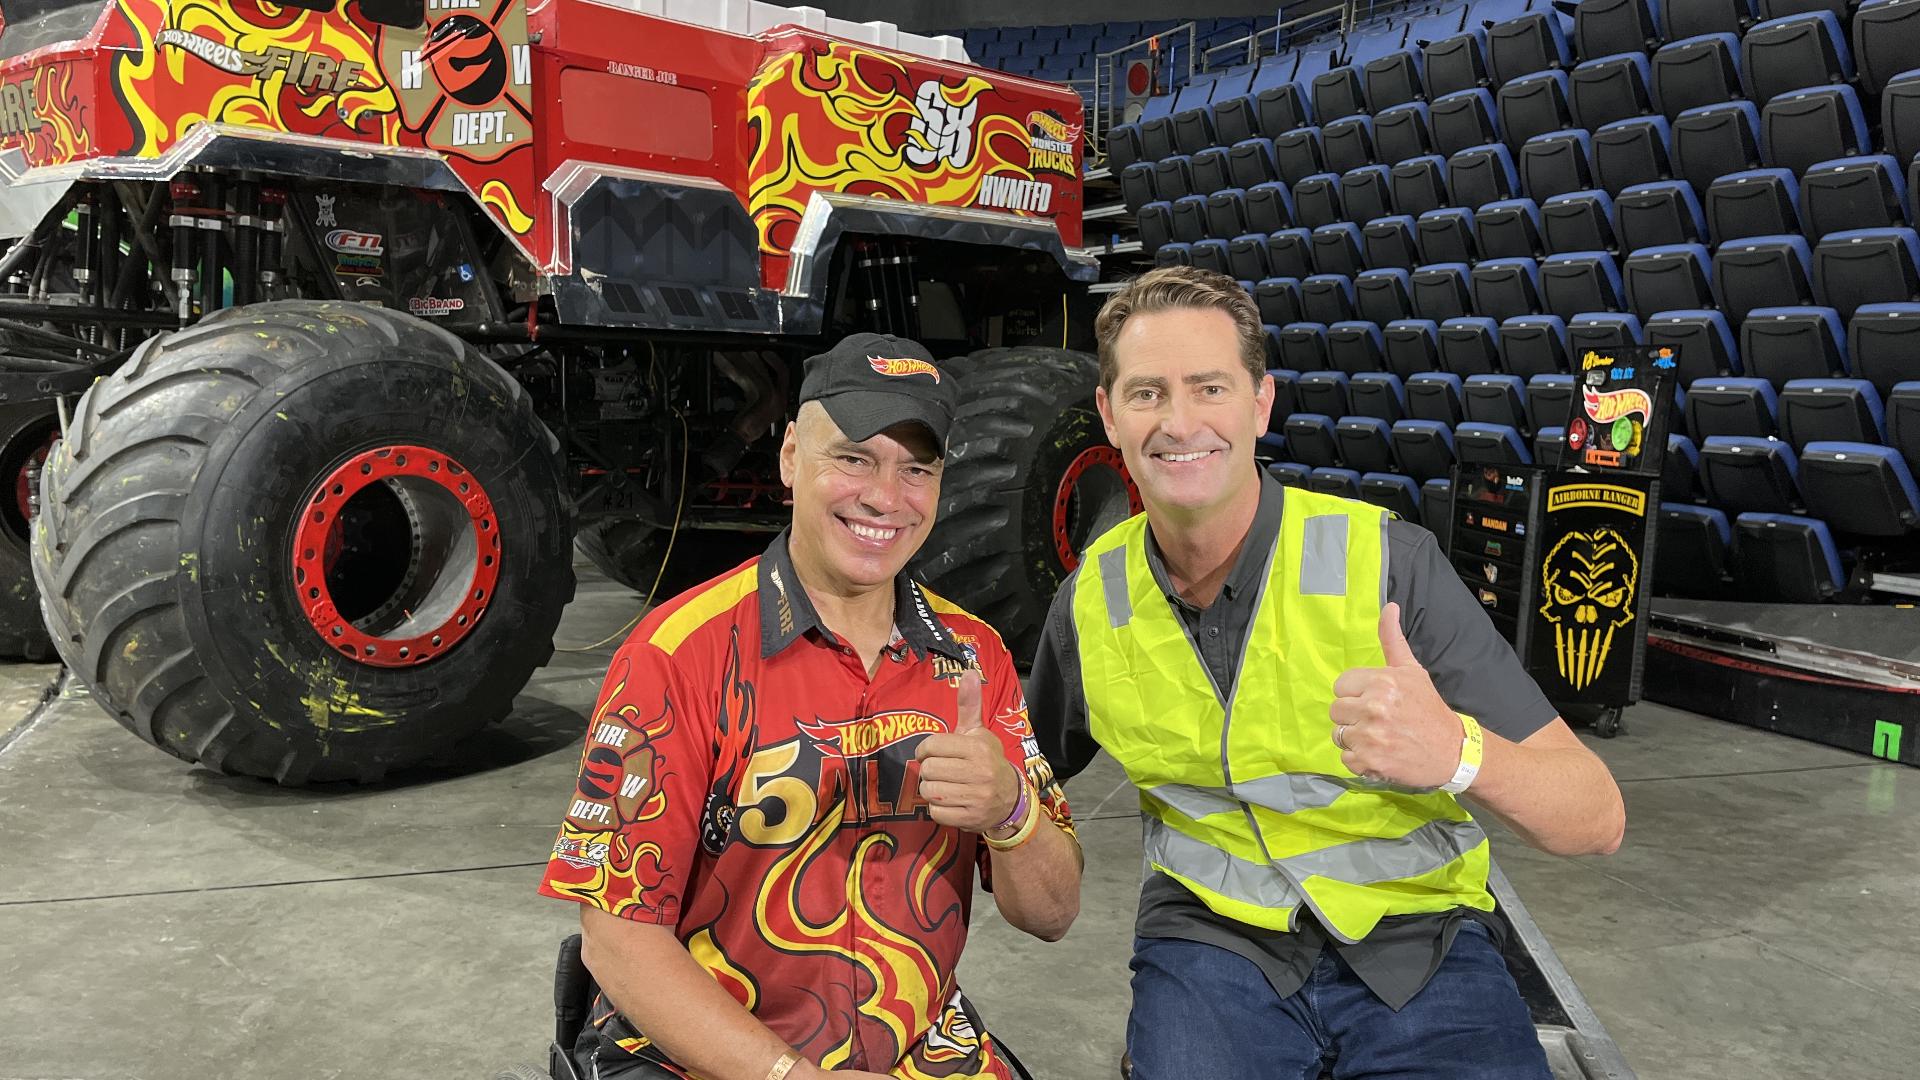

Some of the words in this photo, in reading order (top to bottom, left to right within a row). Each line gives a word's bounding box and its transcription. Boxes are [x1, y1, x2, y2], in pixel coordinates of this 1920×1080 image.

[256, 45, 365, 93] FIRE
[607, 60, 655, 81] RANGER
[452, 110, 515, 147] DEPT.
[1030, 136, 1073, 154] MONSTER
[1028, 148, 1077, 178] TRUCKS
[978, 175, 1053, 213] HWMTFD
[1553, 489, 1601, 505] AIRBORNE
[1602, 489, 1639, 508] RANGER
[594, 723, 629, 748] FIRE
[619, 773, 648, 799] W
[569, 799, 612, 825] DEPT.
